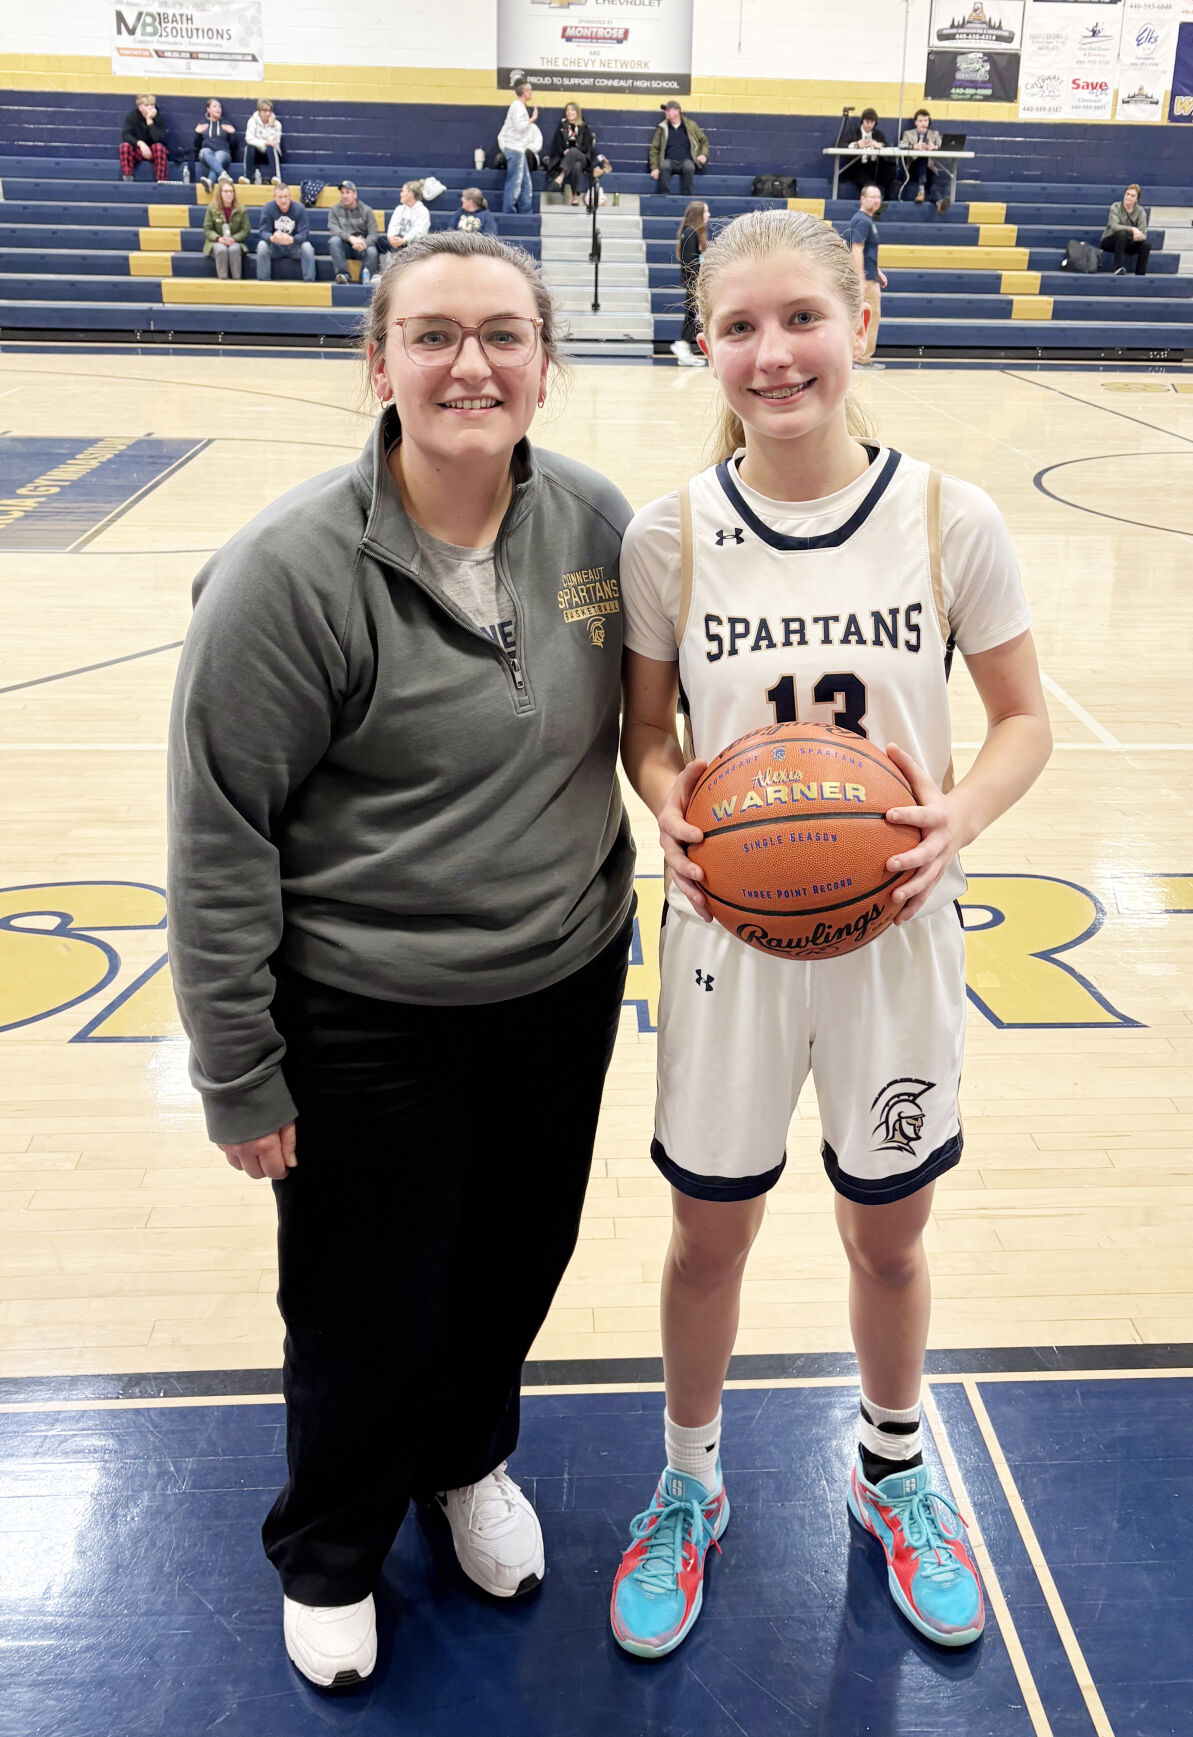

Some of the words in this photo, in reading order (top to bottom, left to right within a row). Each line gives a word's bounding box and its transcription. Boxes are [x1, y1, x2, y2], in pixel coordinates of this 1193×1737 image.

[162, 12, 194, 25] BATH
[163, 26, 232, 41] SOLUTIONS
[565, 27, 625, 38] MONTROSE
[540, 56, 560, 67] THE
[562, 57, 597, 68] CHEVY
[599, 58, 650, 70] NETWORK
[526, 76, 552, 84] PROUD
[552, 77, 562, 85] TO
[563, 77, 594, 85] SUPPORT
[594, 78, 633, 87] CONNEAUT
[633, 80, 651, 88] HIGH
[651, 80, 680, 89] SCHOOL
[1071, 78, 1108, 91] Save
[561, 566, 605, 587] CONNEAUT
[557, 579, 620, 609] SPARTANS
[564, 601, 619, 621] BASKETBALL
[704, 601, 923, 664] SPARTANS
[765, 671, 868, 741] 13
[707, 755, 758, 791] CONNEAUT
[800, 747, 863, 768] SPARTANS
[752, 766, 803, 788] Alexis
[712, 781, 866, 822] WARNER
[743, 835, 782, 853] SINGLE
[790, 832, 837, 842] SEASON
[736, 903, 885, 954] Rawlings
